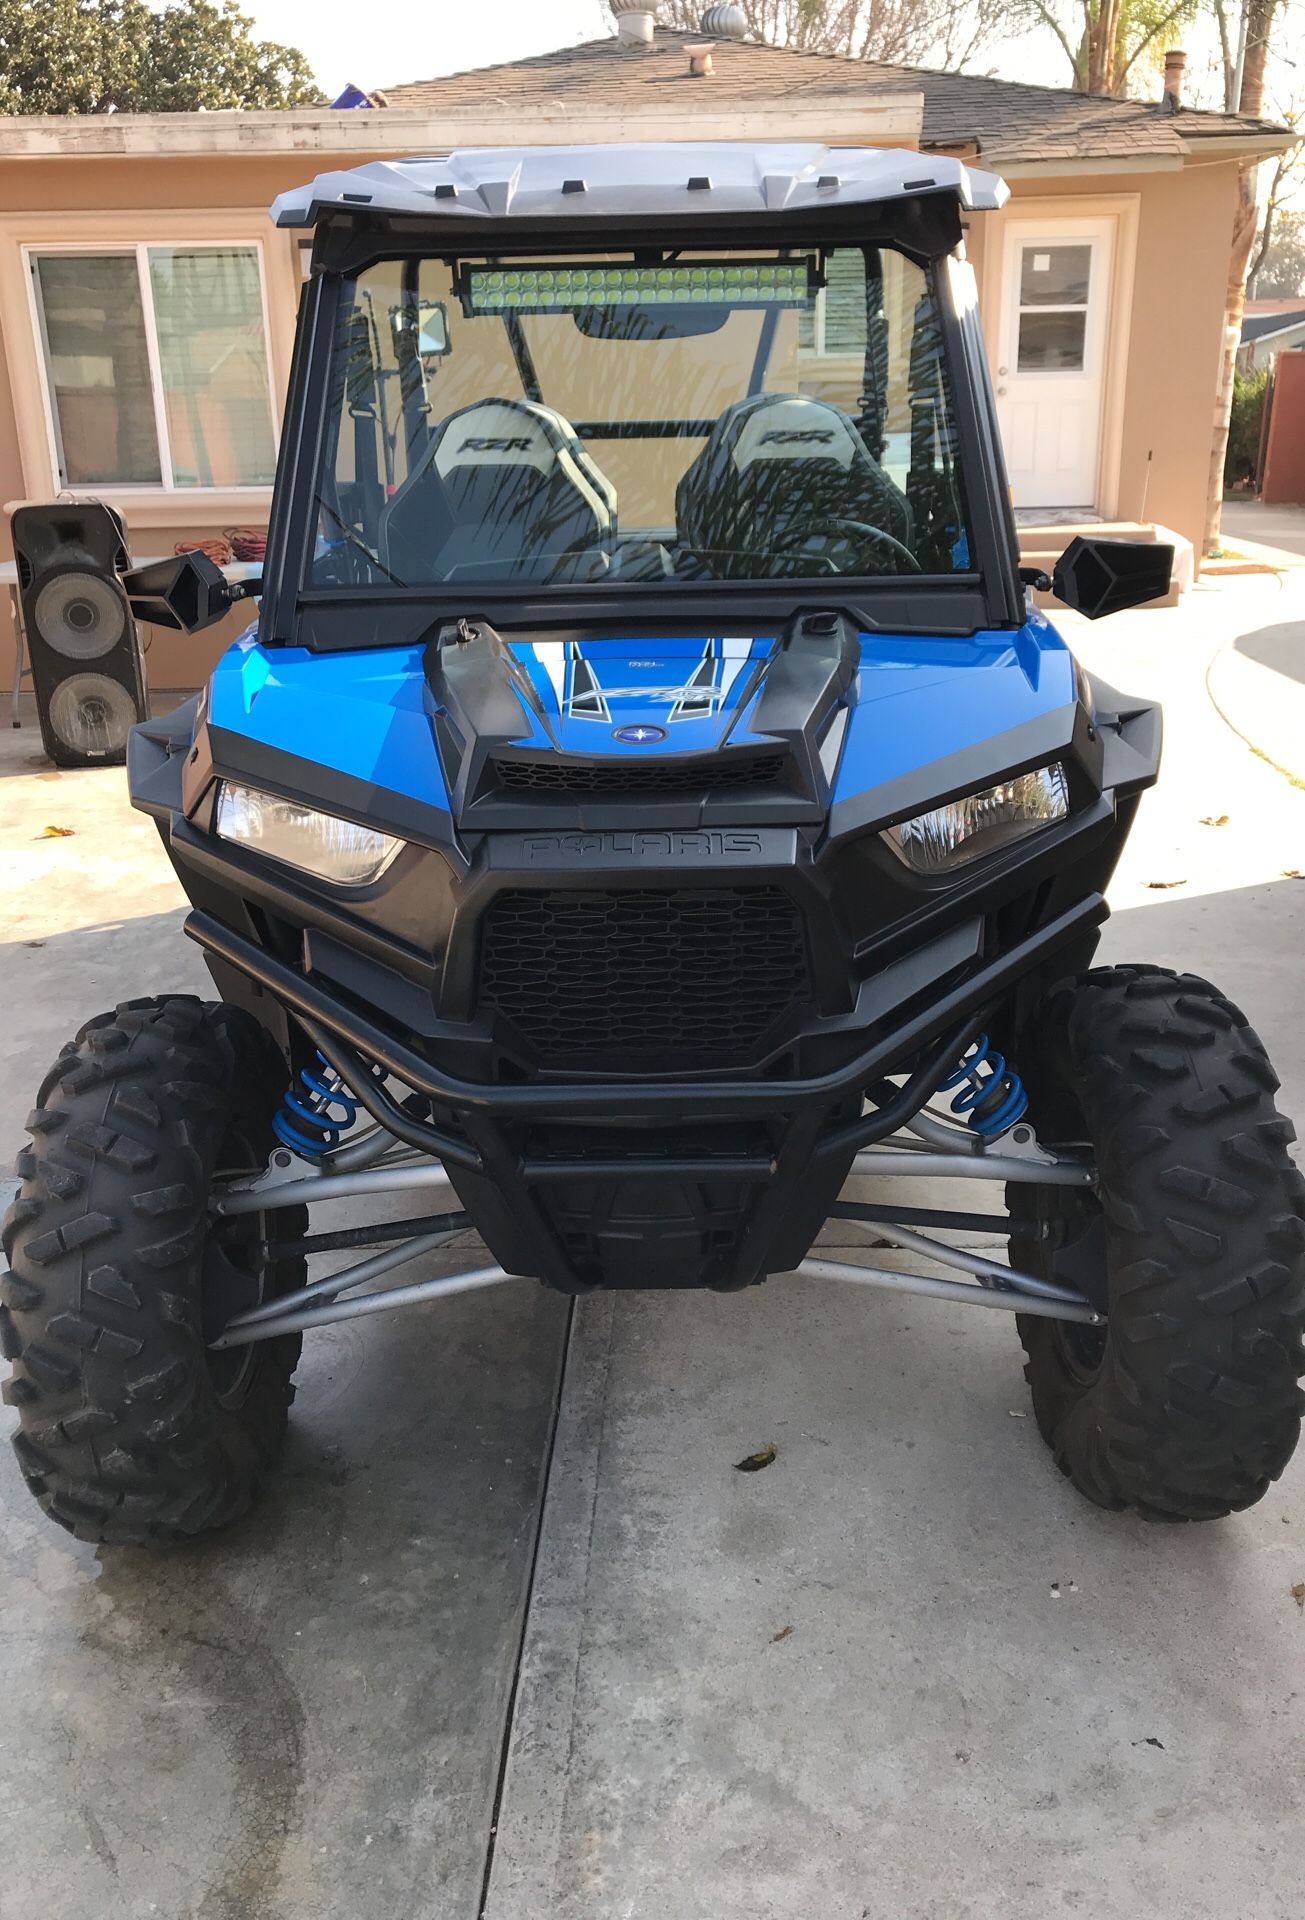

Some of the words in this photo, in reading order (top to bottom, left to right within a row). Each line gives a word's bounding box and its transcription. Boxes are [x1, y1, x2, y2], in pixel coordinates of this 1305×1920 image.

[456, 437, 534, 454] RZR
[756, 429, 836, 446] RZR
[521, 832, 762, 860] POLARIS
